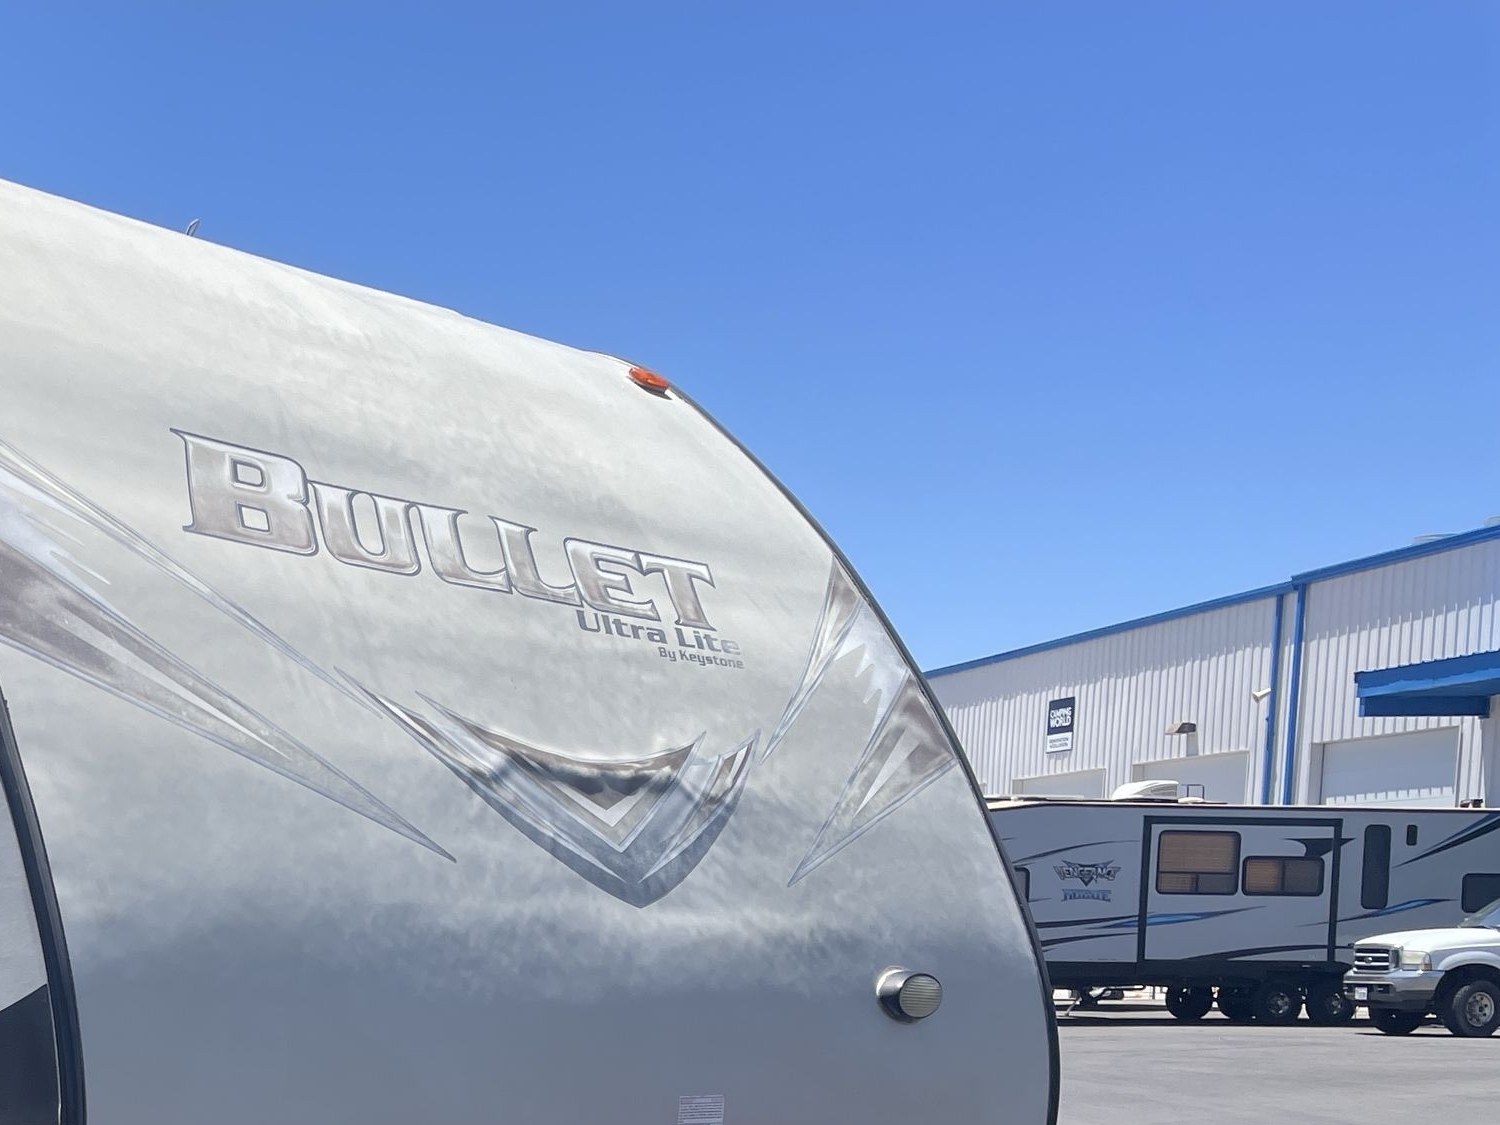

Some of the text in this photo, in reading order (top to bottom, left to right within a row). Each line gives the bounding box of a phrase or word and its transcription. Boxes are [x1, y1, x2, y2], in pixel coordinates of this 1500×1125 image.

[169, 427, 716, 632] BULLET
[576, 610, 741, 655] Ultra Lite
[659, 647, 745, 669] By Keystone
